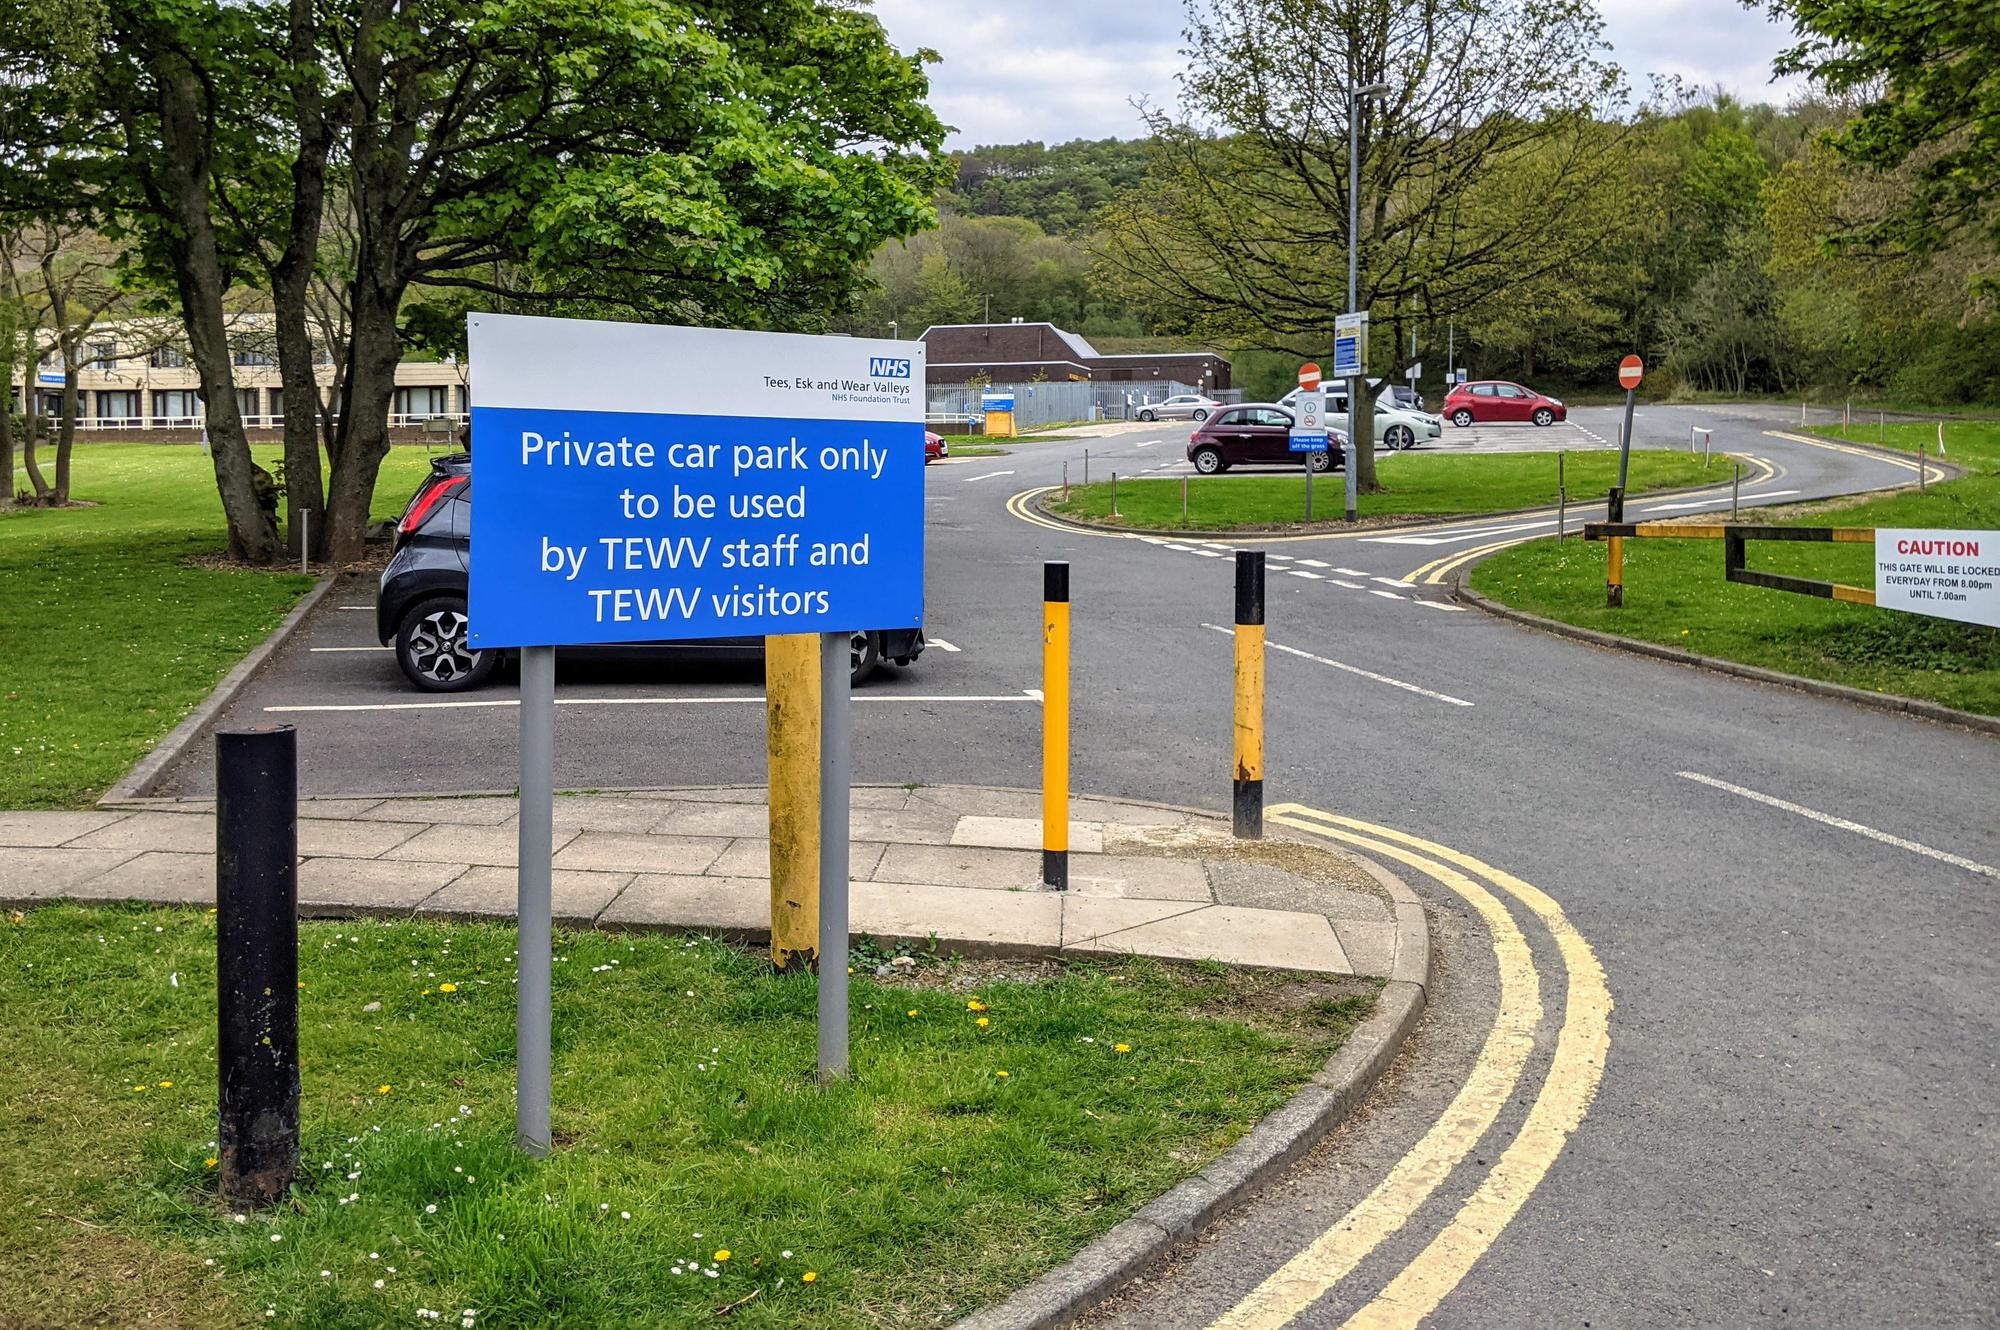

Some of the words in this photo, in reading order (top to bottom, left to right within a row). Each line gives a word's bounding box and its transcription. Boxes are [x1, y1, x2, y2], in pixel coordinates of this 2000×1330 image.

[871, 359, 909, 377] NHS
[764, 376, 791, 389] Tees,
[796, 378, 813, 389] Esk
[817, 379, 837, 390] and
[841, 380, 870, 391] Wear
[874, 382, 909, 396] Valleys
[850, 395, 890, 403] Foundation
[522, 432, 654, 467] Private
[668, 444, 720, 468] car
[734, 437, 808, 476] park
[820, 439, 887, 479] only
[620, 489, 659, 518] to
[674, 485, 715, 518] be
[730, 486, 804, 518] used
[542, 537, 587, 580] by
[600, 537, 711, 570] TEWV
[723, 534, 799, 568] staff
[810, 534, 868, 566] and
[1898, 540, 1978, 556] CAUTION
[1879, 563, 1897, 571] THIS
[1900, 564, 1921, 572] GATE
[1924, 565, 1945, 573] WILL
[1948, 566, 1959, 574] BE
[1963, 567, 2000, 576] LOCKED
[1886, 576, 1930, 585] EVERYDAY
[1933, 578, 1958, 587] FROM
[1961, 580, 1992, 590] 8.00pm
[588, 587, 701, 622] TEWV
[712, 584, 829, 617] visitors
[1910, 590, 1934, 599] UNTIL
[1937, 592, 1966, 601] 7.00am
